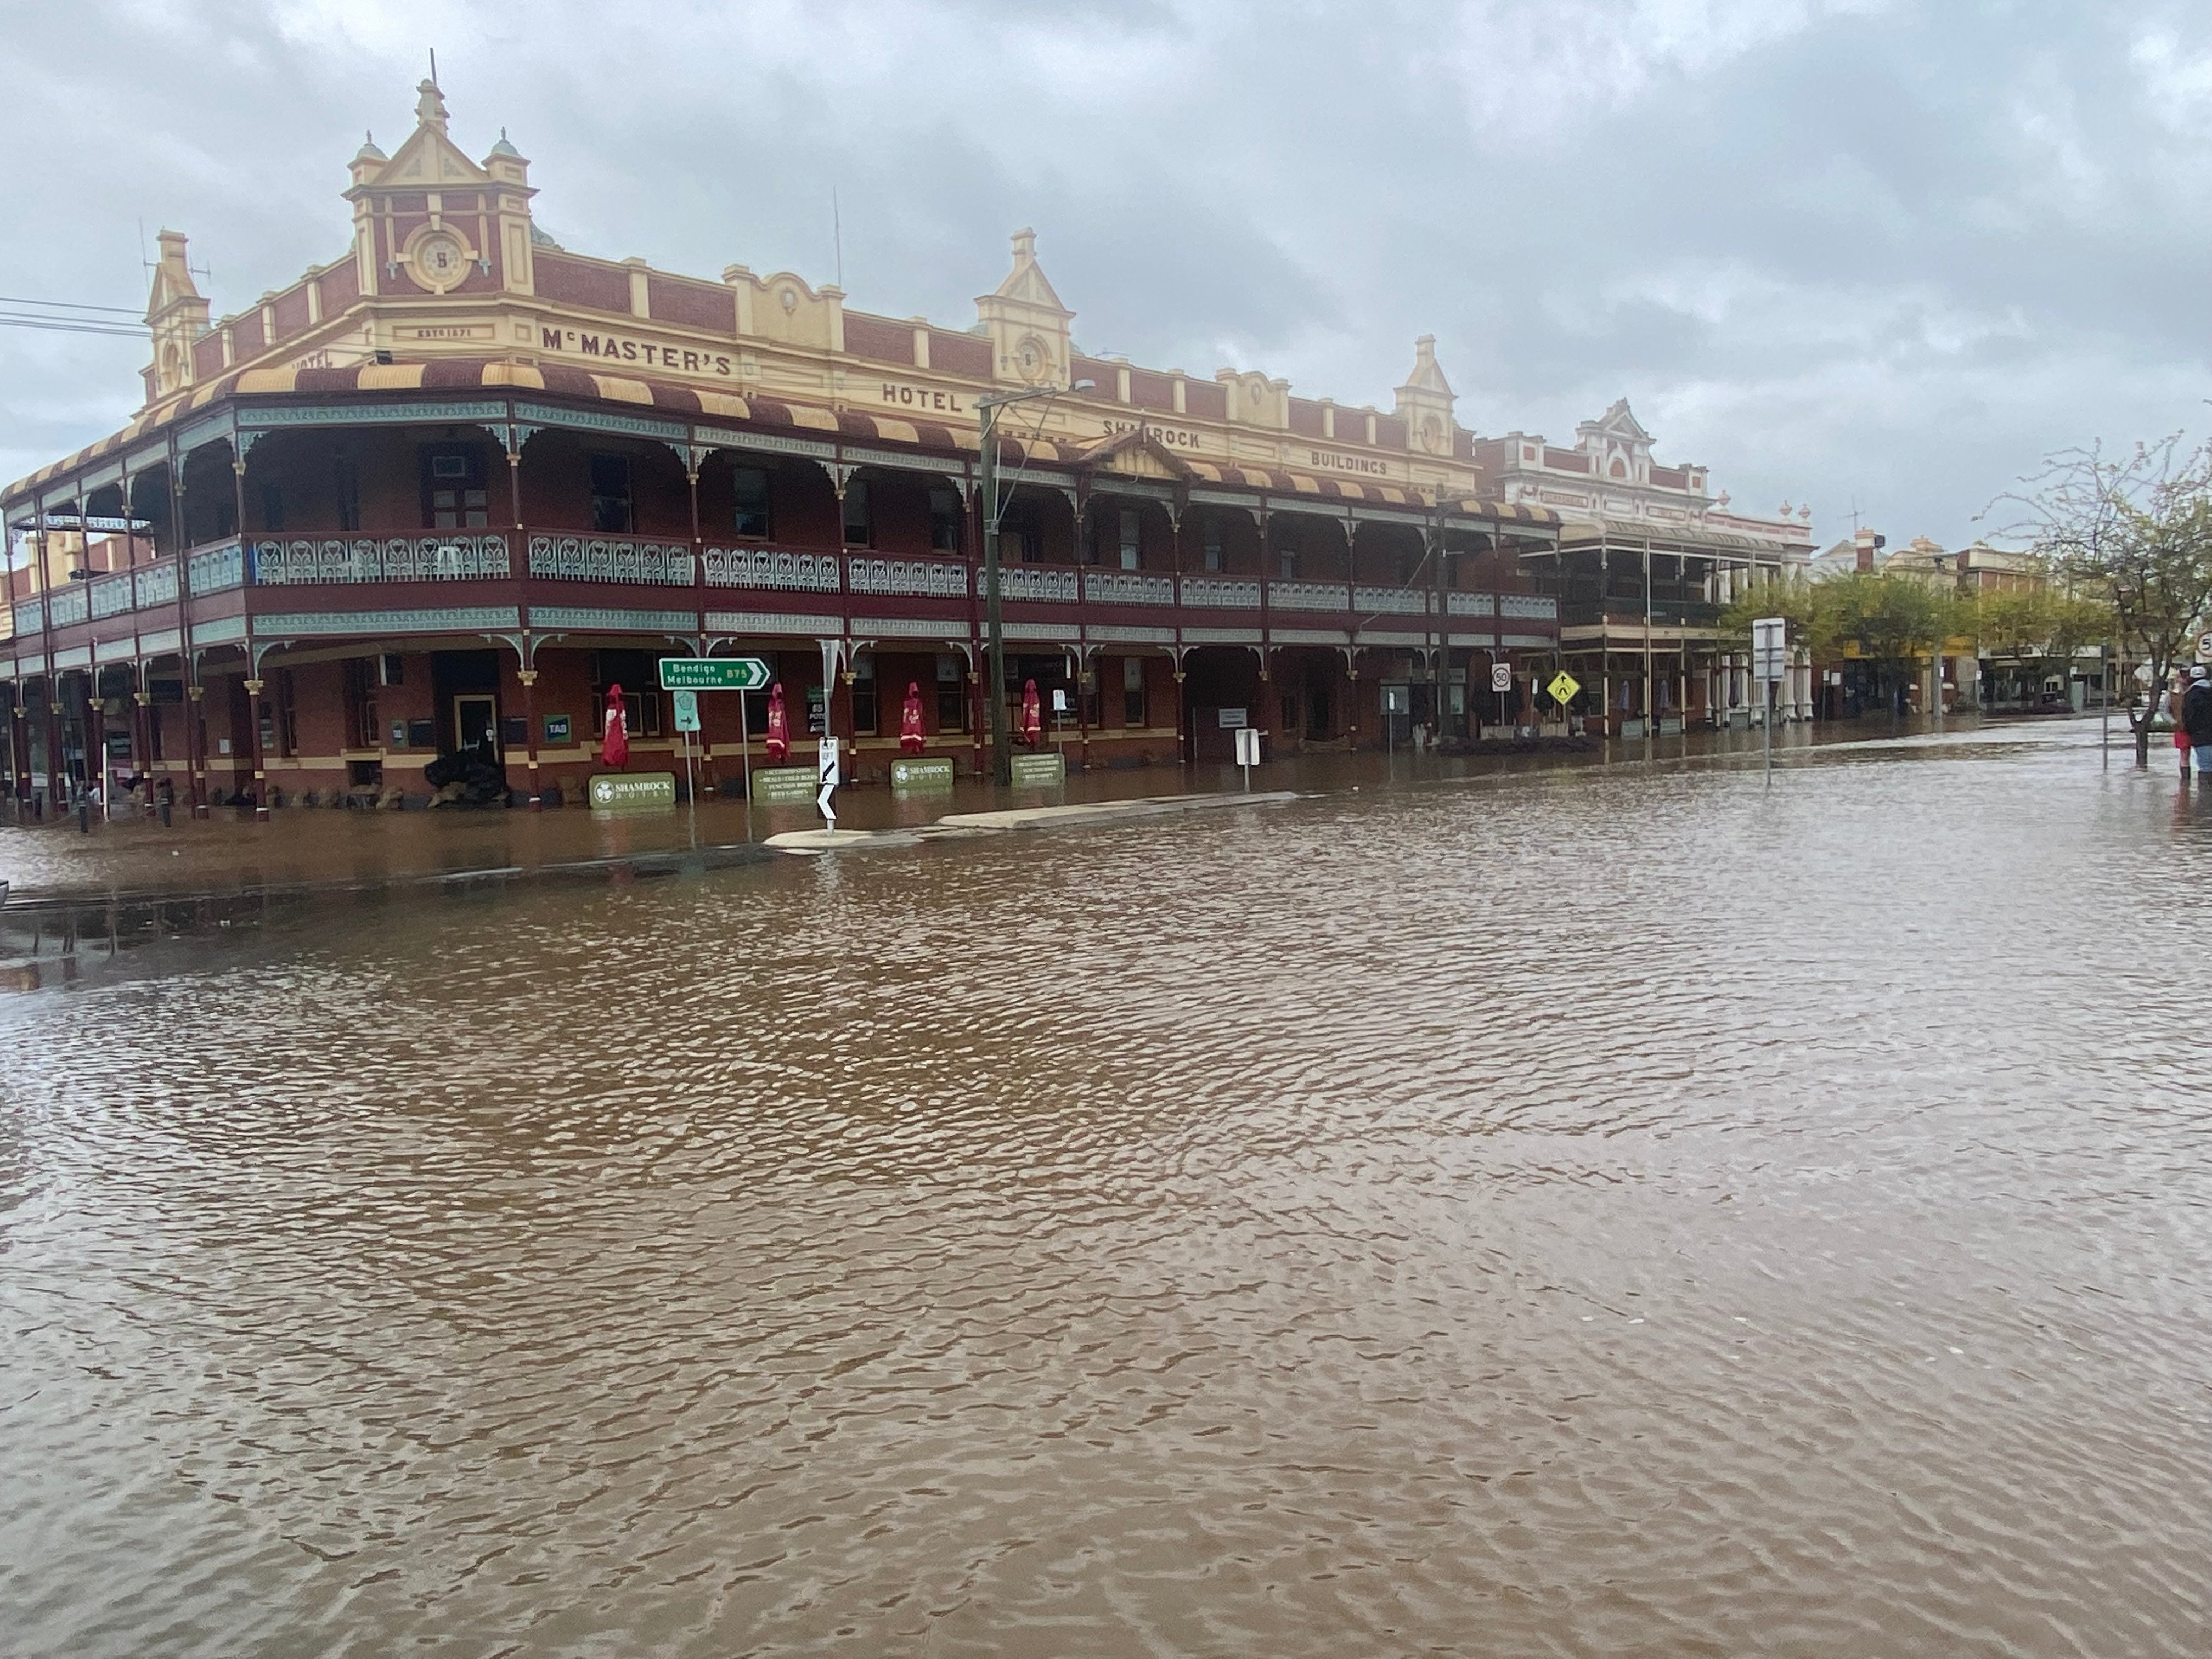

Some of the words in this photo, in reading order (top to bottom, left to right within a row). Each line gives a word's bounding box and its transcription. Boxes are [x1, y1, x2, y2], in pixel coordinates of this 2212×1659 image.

[882, 383, 962, 413] HOTEL
[1103, 420, 1200, 449] SHROCK
[1311, 451, 1386, 475] BUILDINGS
[2202, 639, 2211, 650] 5
[673, 664, 715, 675] Bendigo
[726, 669, 747, 679] B75
[667, 676, 723, 684] Melbourne
[1496, 673, 1506, 682] 50
[549, 725, 566, 733] TAB
[615, 781, 670, 792] SHAMROCK
